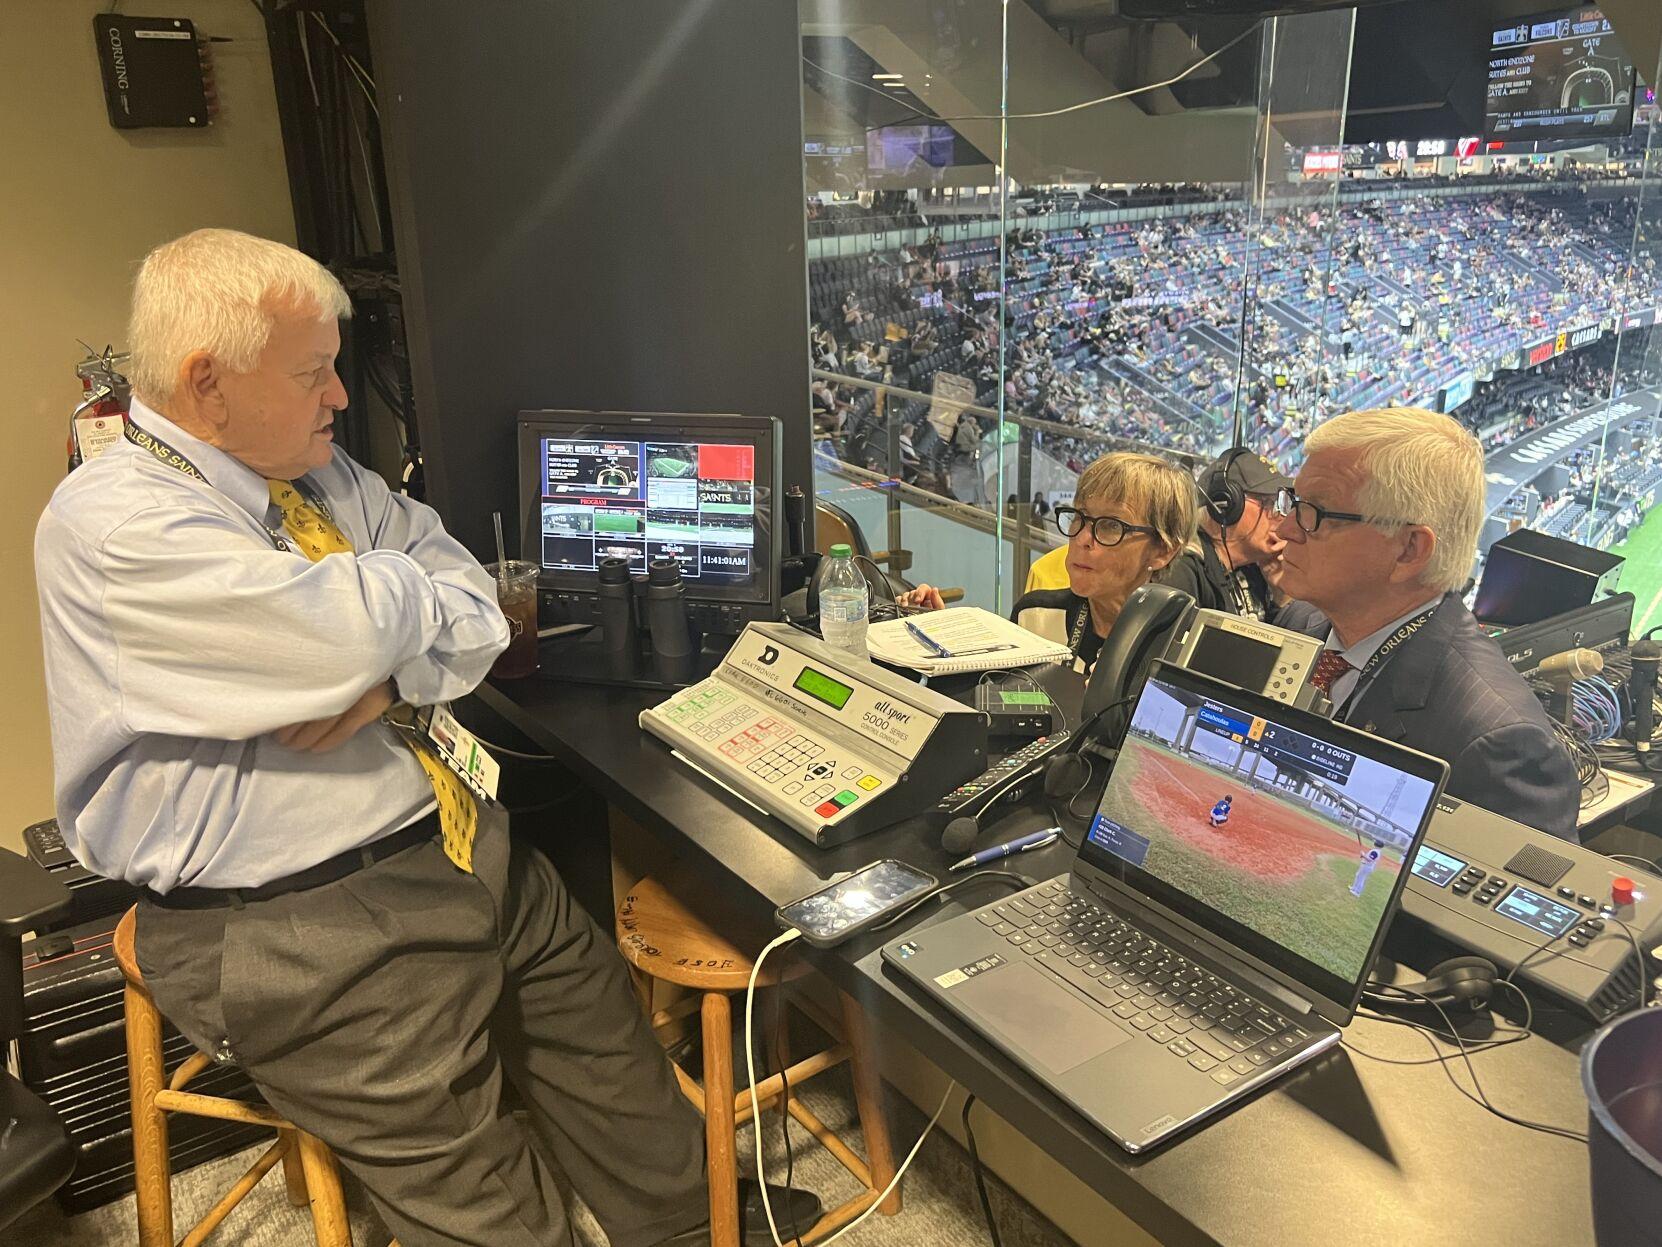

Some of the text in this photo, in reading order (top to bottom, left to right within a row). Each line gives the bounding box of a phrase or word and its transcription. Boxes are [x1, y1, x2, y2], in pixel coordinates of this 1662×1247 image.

[109, 27, 129, 89] CORNING
[580, 498, 607, 506] PROGRAM
[1230, 623, 1275, 641] HOUSE CONTROLS
[1360, 615, 1427, 680] NEW ORLEANS
[741, 658, 781, 683] DAKTRONICS
[1203, 700, 1224, 713] Jesters
[860, 722, 900, 747] CONTROL CONSOLE
[862, 711, 910, 742] 5000 SERIES
[1269, 730, 1276, 739] 2
[1331, 749, 1351, 762] OUTS
